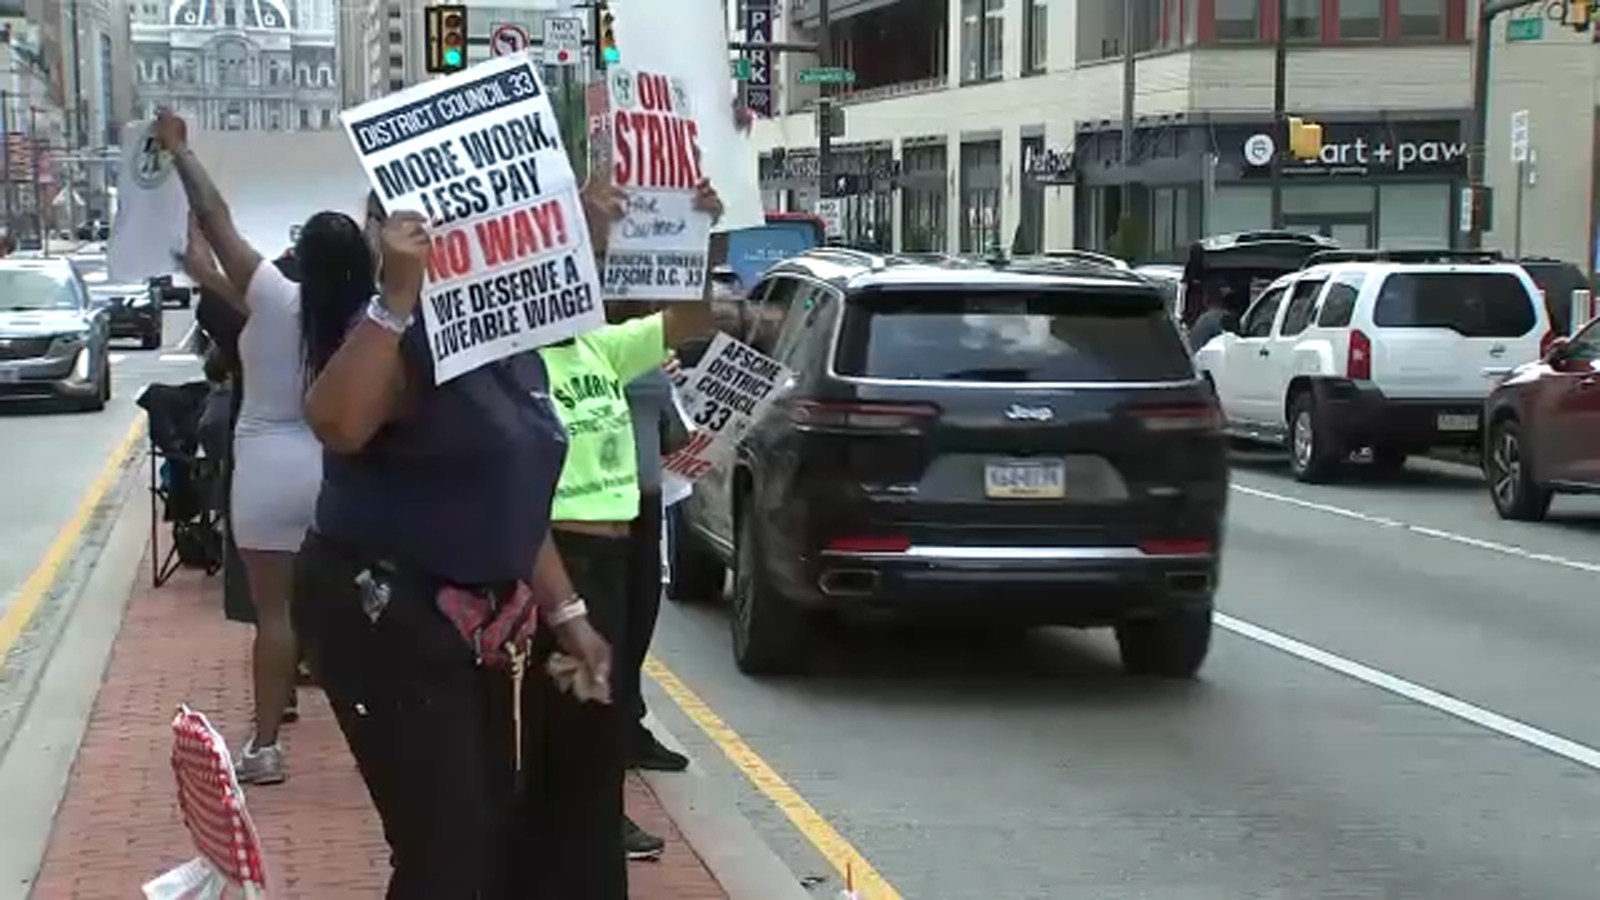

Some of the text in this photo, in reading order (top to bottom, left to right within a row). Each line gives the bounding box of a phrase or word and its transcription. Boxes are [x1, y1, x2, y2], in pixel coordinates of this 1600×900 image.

[552, 21, 574, 31] NO
[751, 12, 767, 83] PARK
[357, 71, 535, 151] DISTRICT COUNCIL 33
[637, 71, 672, 112] ON
[373, 111, 558, 201] MORE WORK,
[614, 110, 702, 189] STRIKE
[1398, 142, 1467, 171] paw
[420, 158, 542, 228] LESS PAY
[427, 200, 569, 284] NO WAY!
[430, 255, 581, 326] WE DESERVE A
[606, 268, 652, 286] AFSCME
[656, 268, 681, 286] D.C.
[433, 283, 595, 362] LIVEABLE WAGE!
[707, 358, 774, 399] DISTRICT
[721, 341, 782, 382] AFSCME
[694, 401, 732, 431] 33
[696, 376, 757, 416] COUNCIL
[1003, 403, 1055, 421] Jeep
